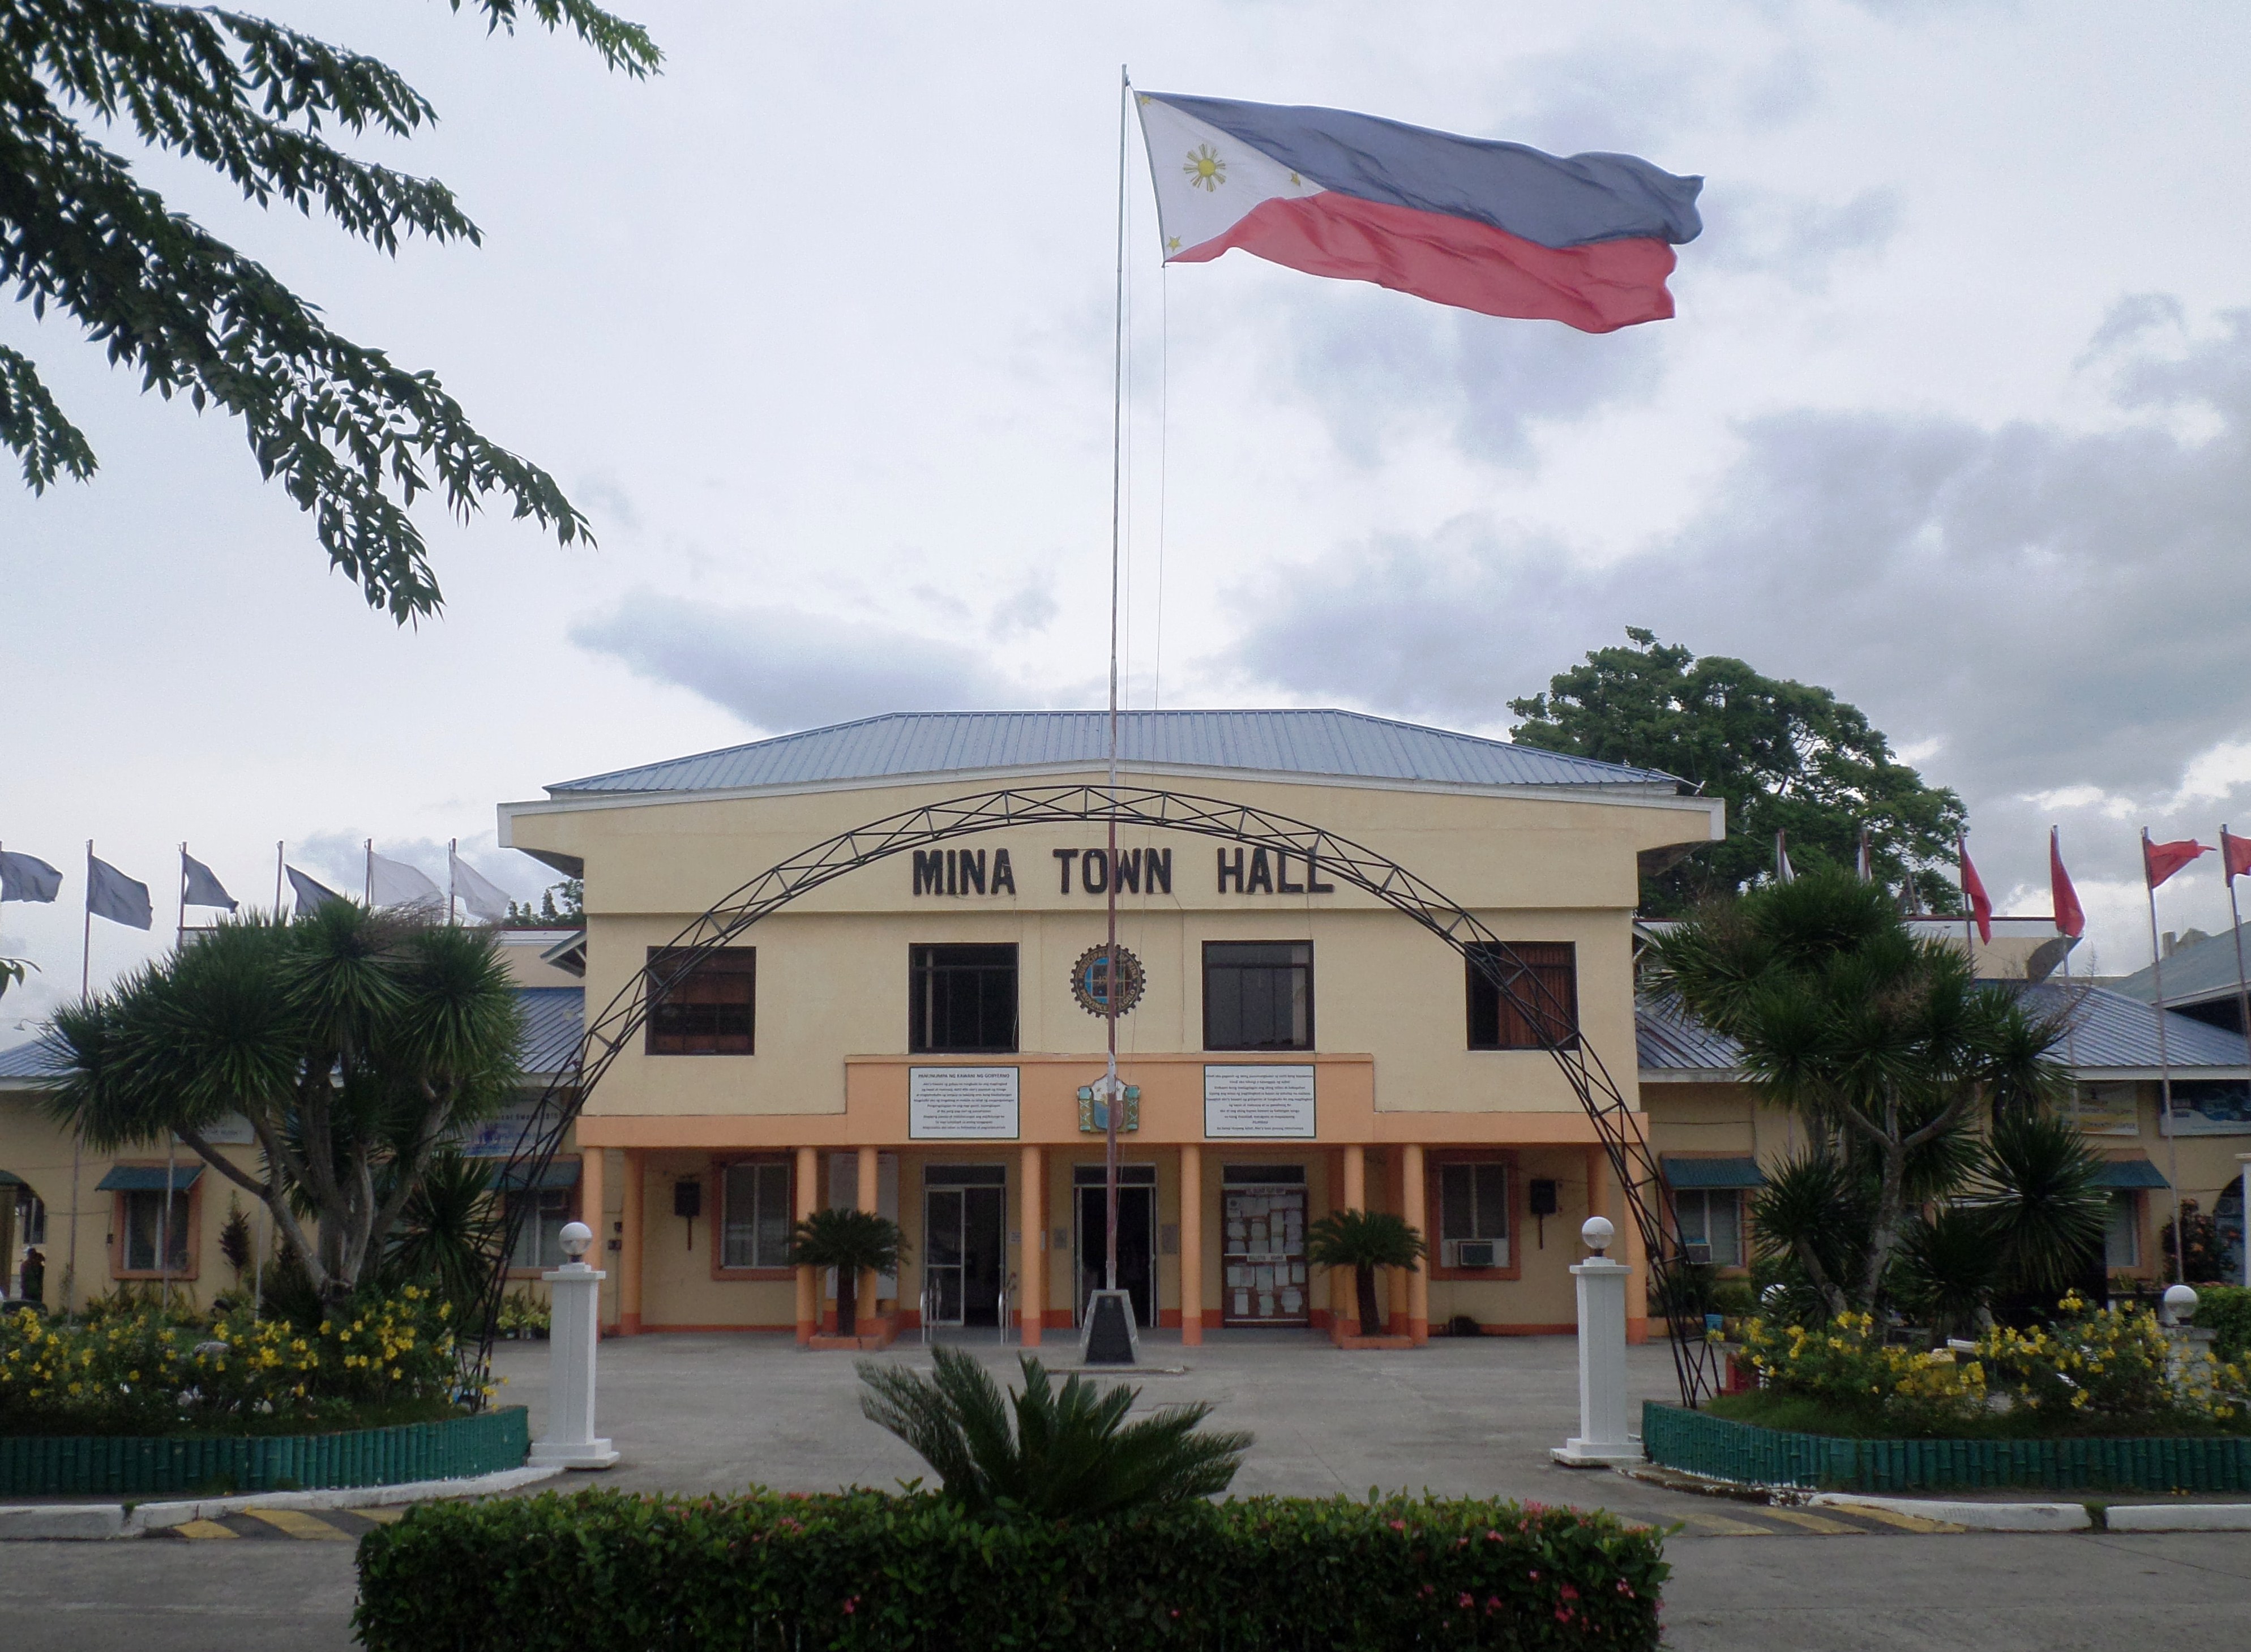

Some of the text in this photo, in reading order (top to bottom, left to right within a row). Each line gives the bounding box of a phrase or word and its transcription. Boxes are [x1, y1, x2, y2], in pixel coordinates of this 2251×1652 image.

[912, 846, 1335, 896] MINA TOWN HALL
